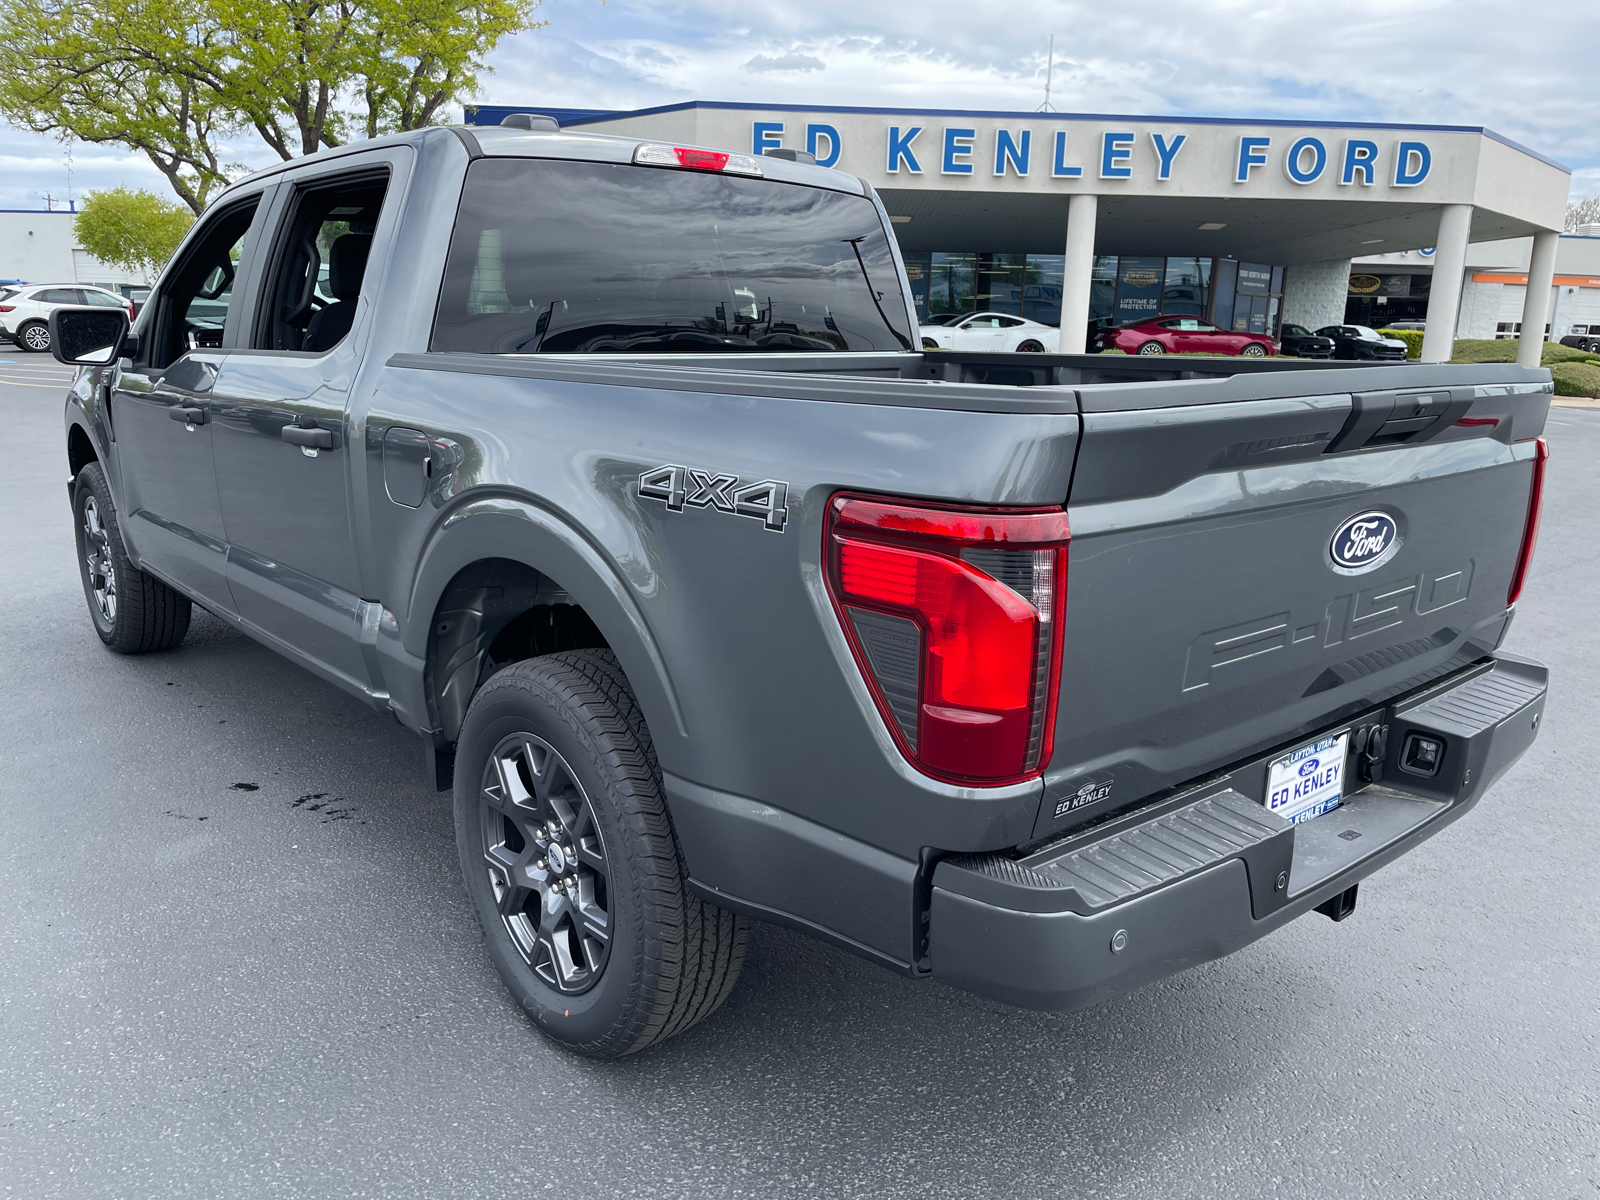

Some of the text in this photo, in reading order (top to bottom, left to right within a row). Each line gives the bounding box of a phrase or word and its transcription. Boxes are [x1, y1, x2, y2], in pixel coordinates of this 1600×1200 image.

[752, 121, 1433, 188] ED KENLEY FORD
[638, 463, 790, 534] 4X4
[1343, 520, 1388, 560] Ford
[869, 629, 917, 646] FORD
[1181, 557, 1476, 693] F-150
[1316, 737, 1333, 751] UTAH
[1302, 760, 1317, 776] Ford
[1055, 785, 1112, 815] ED KENLEY
[1270, 787, 1289, 810] ED
[1293, 763, 1341, 800] KENLEY
[1294, 801, 1326, 825] KENLEY
